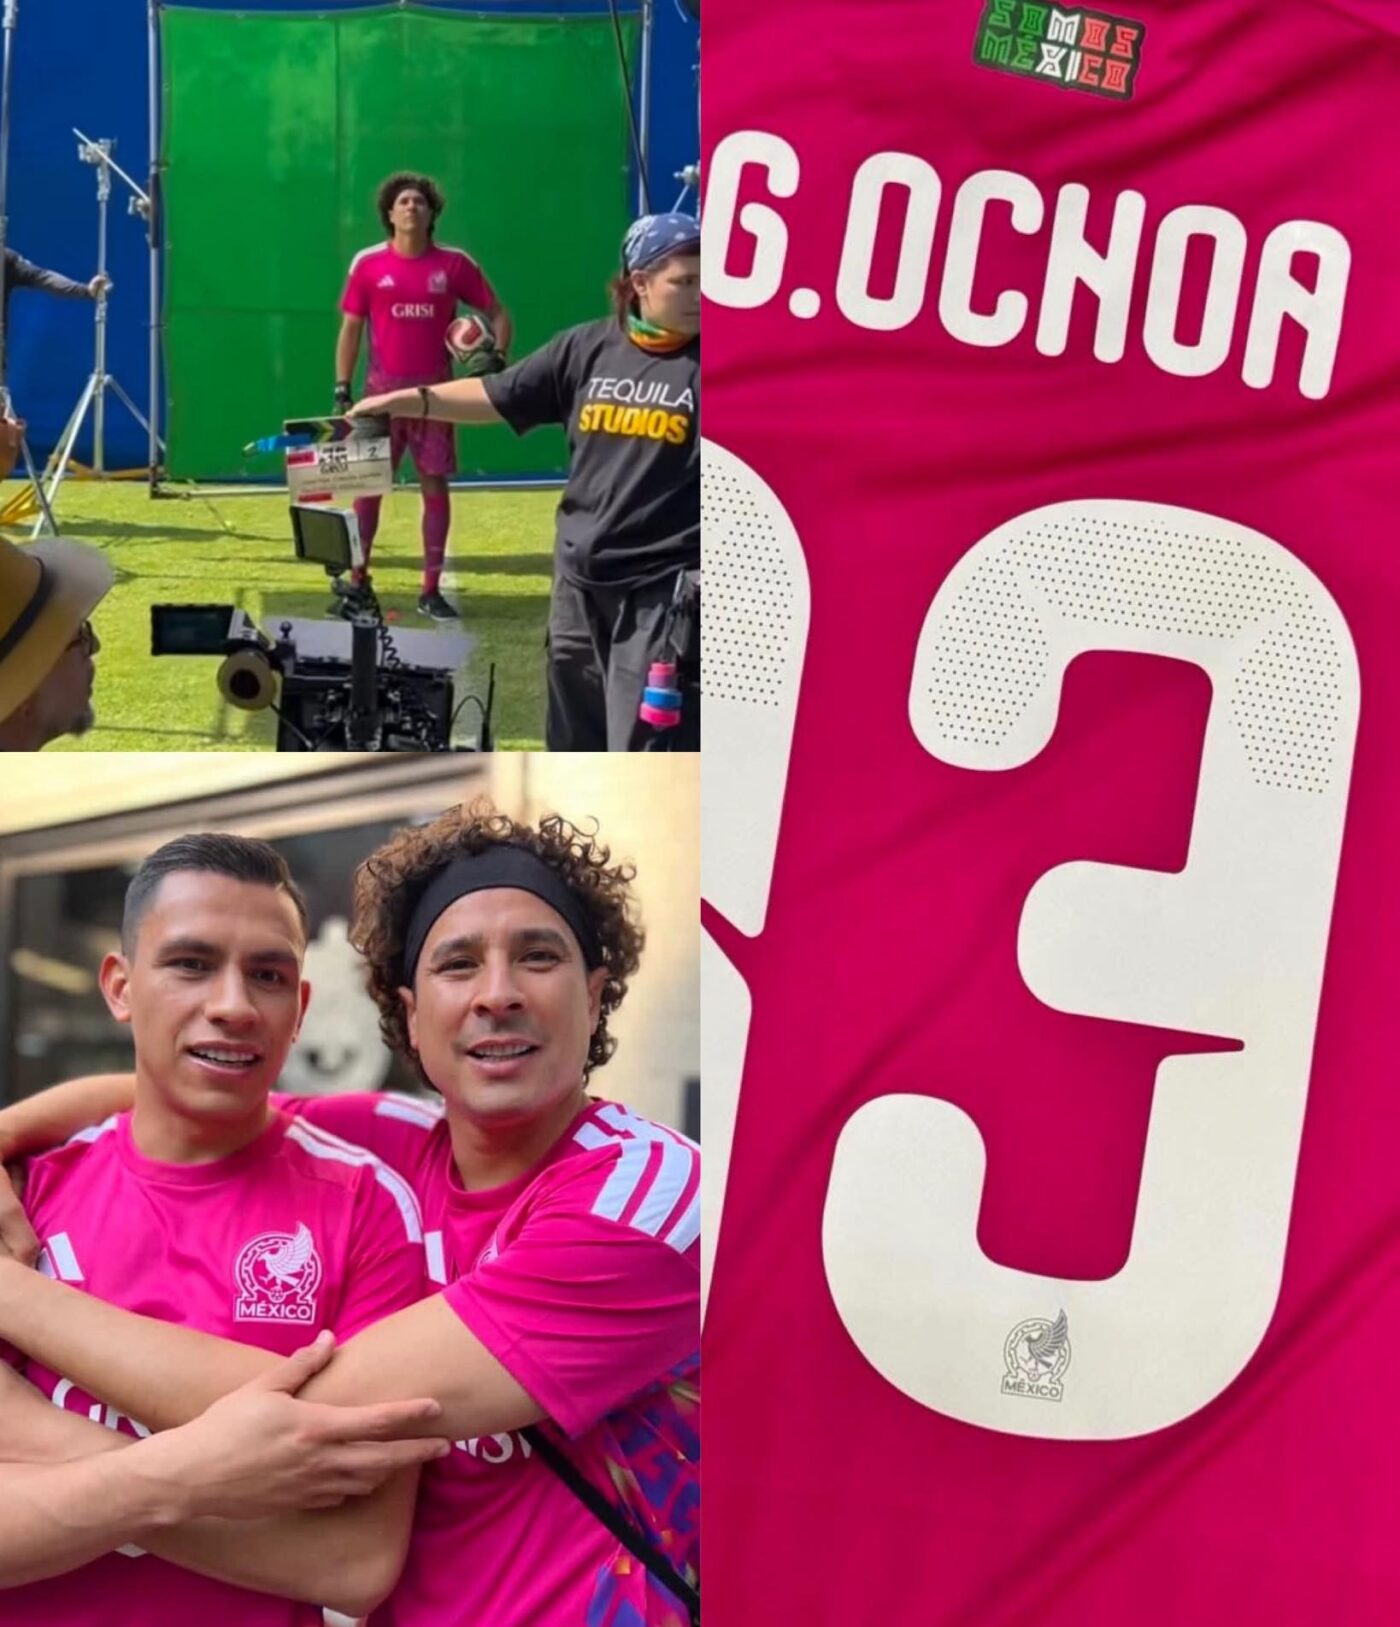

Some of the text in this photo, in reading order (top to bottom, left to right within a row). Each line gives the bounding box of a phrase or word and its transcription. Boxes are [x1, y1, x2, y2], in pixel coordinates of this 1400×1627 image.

[987, 0, 1138, 59] SOMOS
[701, 130, 1352, 400] G.OCHOA
[391, 303, 434, 318] GRISI
[587, 377, 694, 413] TEQUILA
[578, 403, 689, 444] STUDIOS
[240, 1301, 311, 1319] MÉXICO
[1004, 1379, 1060, 1398] MÉXICO
